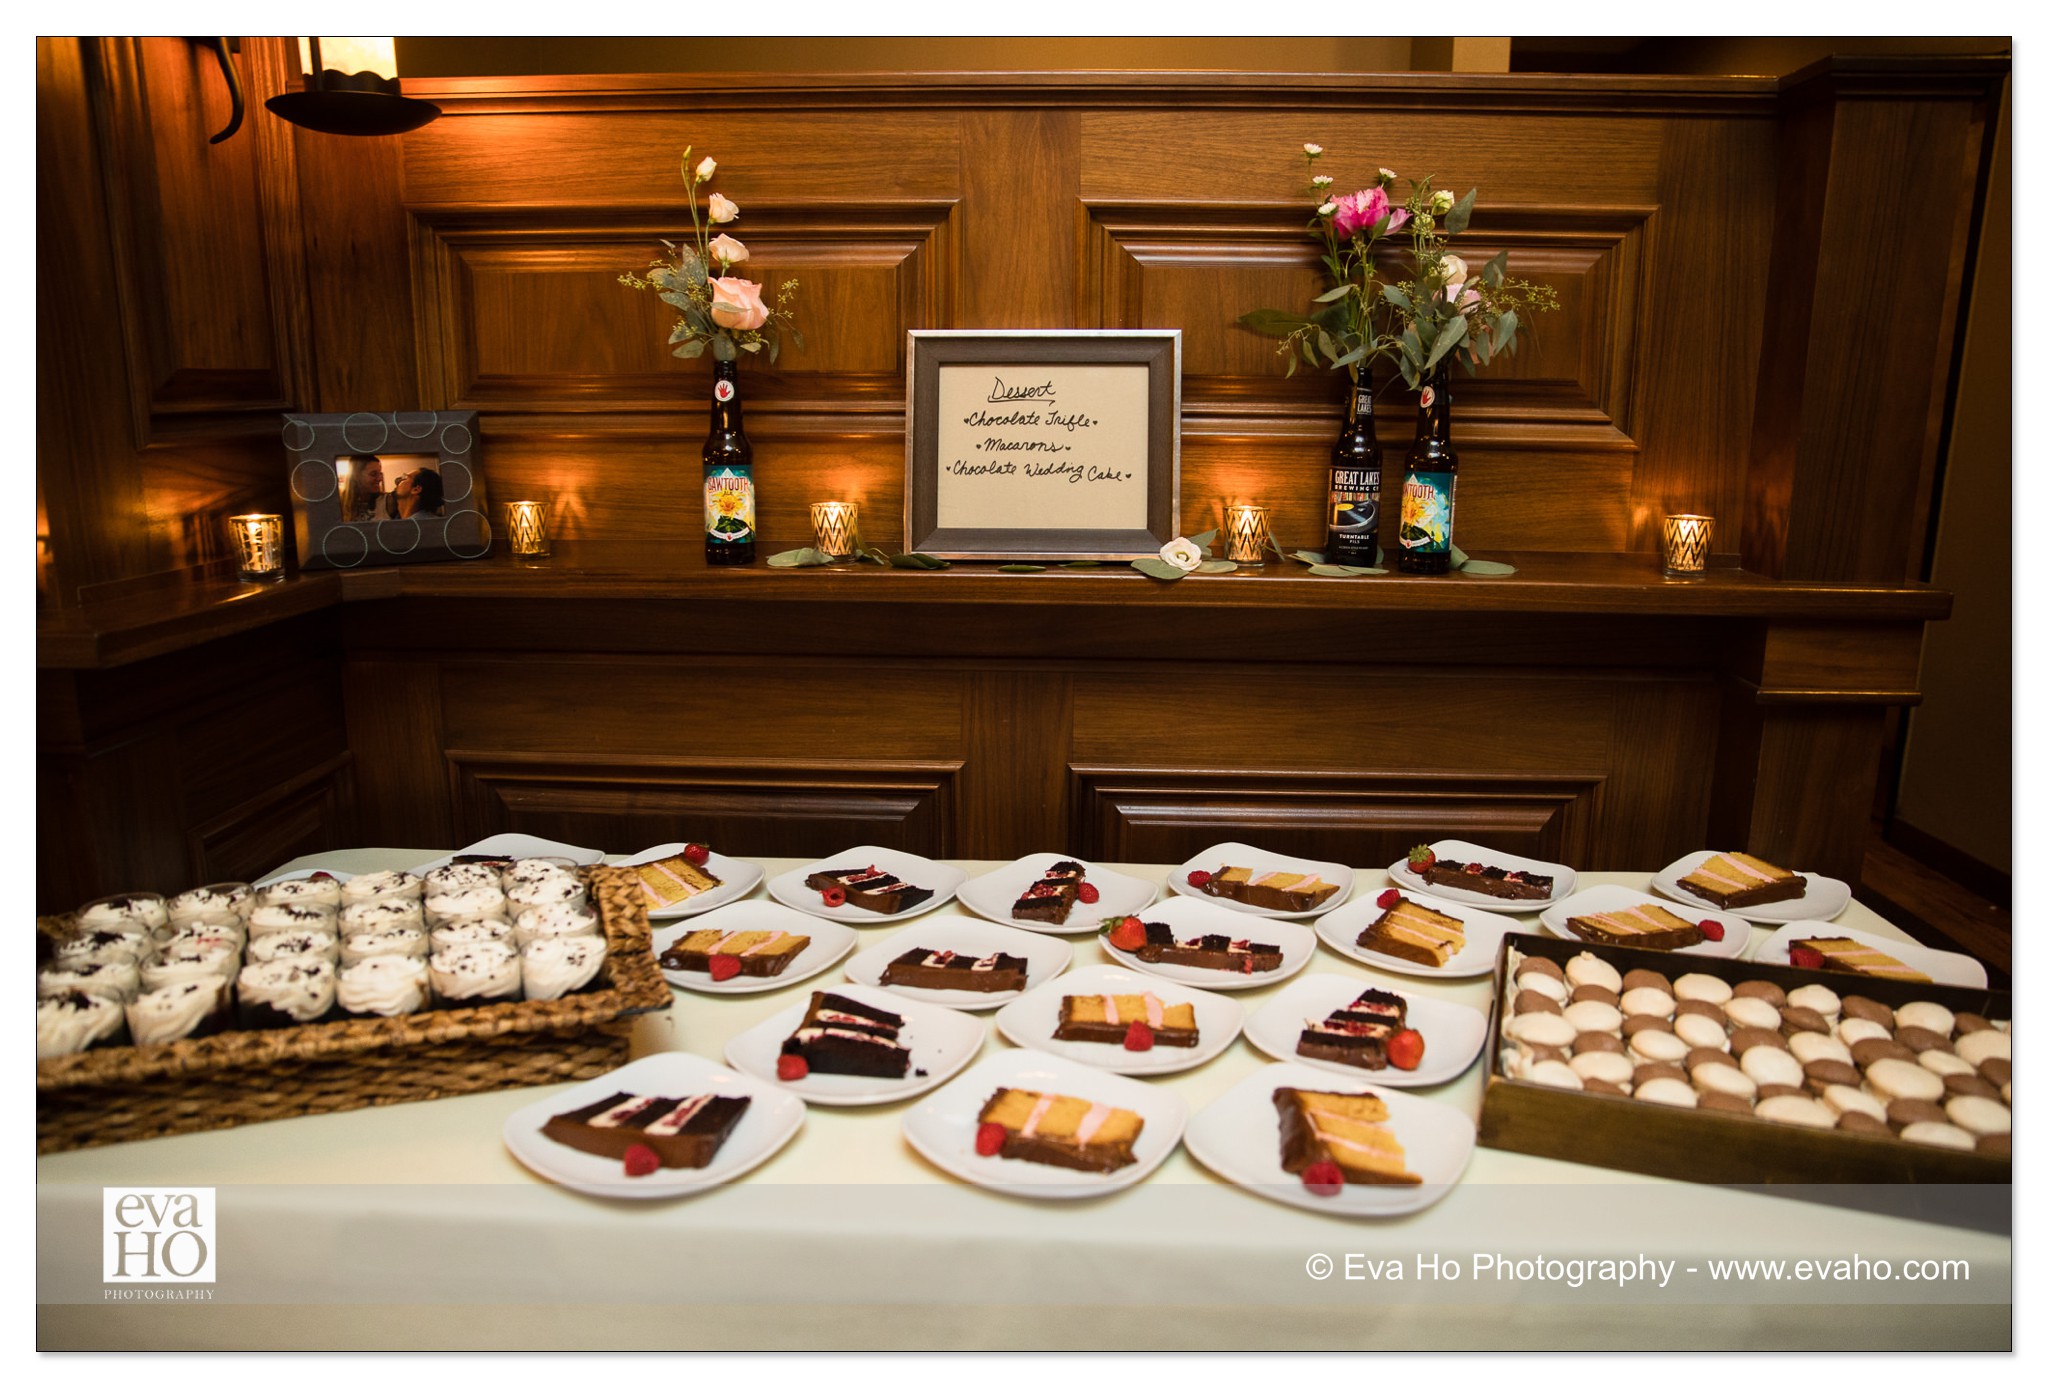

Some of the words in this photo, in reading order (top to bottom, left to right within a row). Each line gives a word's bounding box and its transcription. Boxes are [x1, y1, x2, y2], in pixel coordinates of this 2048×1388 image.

[988, 376, 1056, 400] Dessert
[969, 411, 1040, 427] Chocolate
[1045, 410, 1090, 431] Trifle
[984, 438, 1064, 452] Macarons
[953, 460, 1017, 476] Chocolate
[1087, 466, 1122, 482] Cake
[1334, 470, 1359, 485] GREAT
[1360, 471, 1380, 486] LAKES
[707, 476, 749, 491] SAWTOOTH
